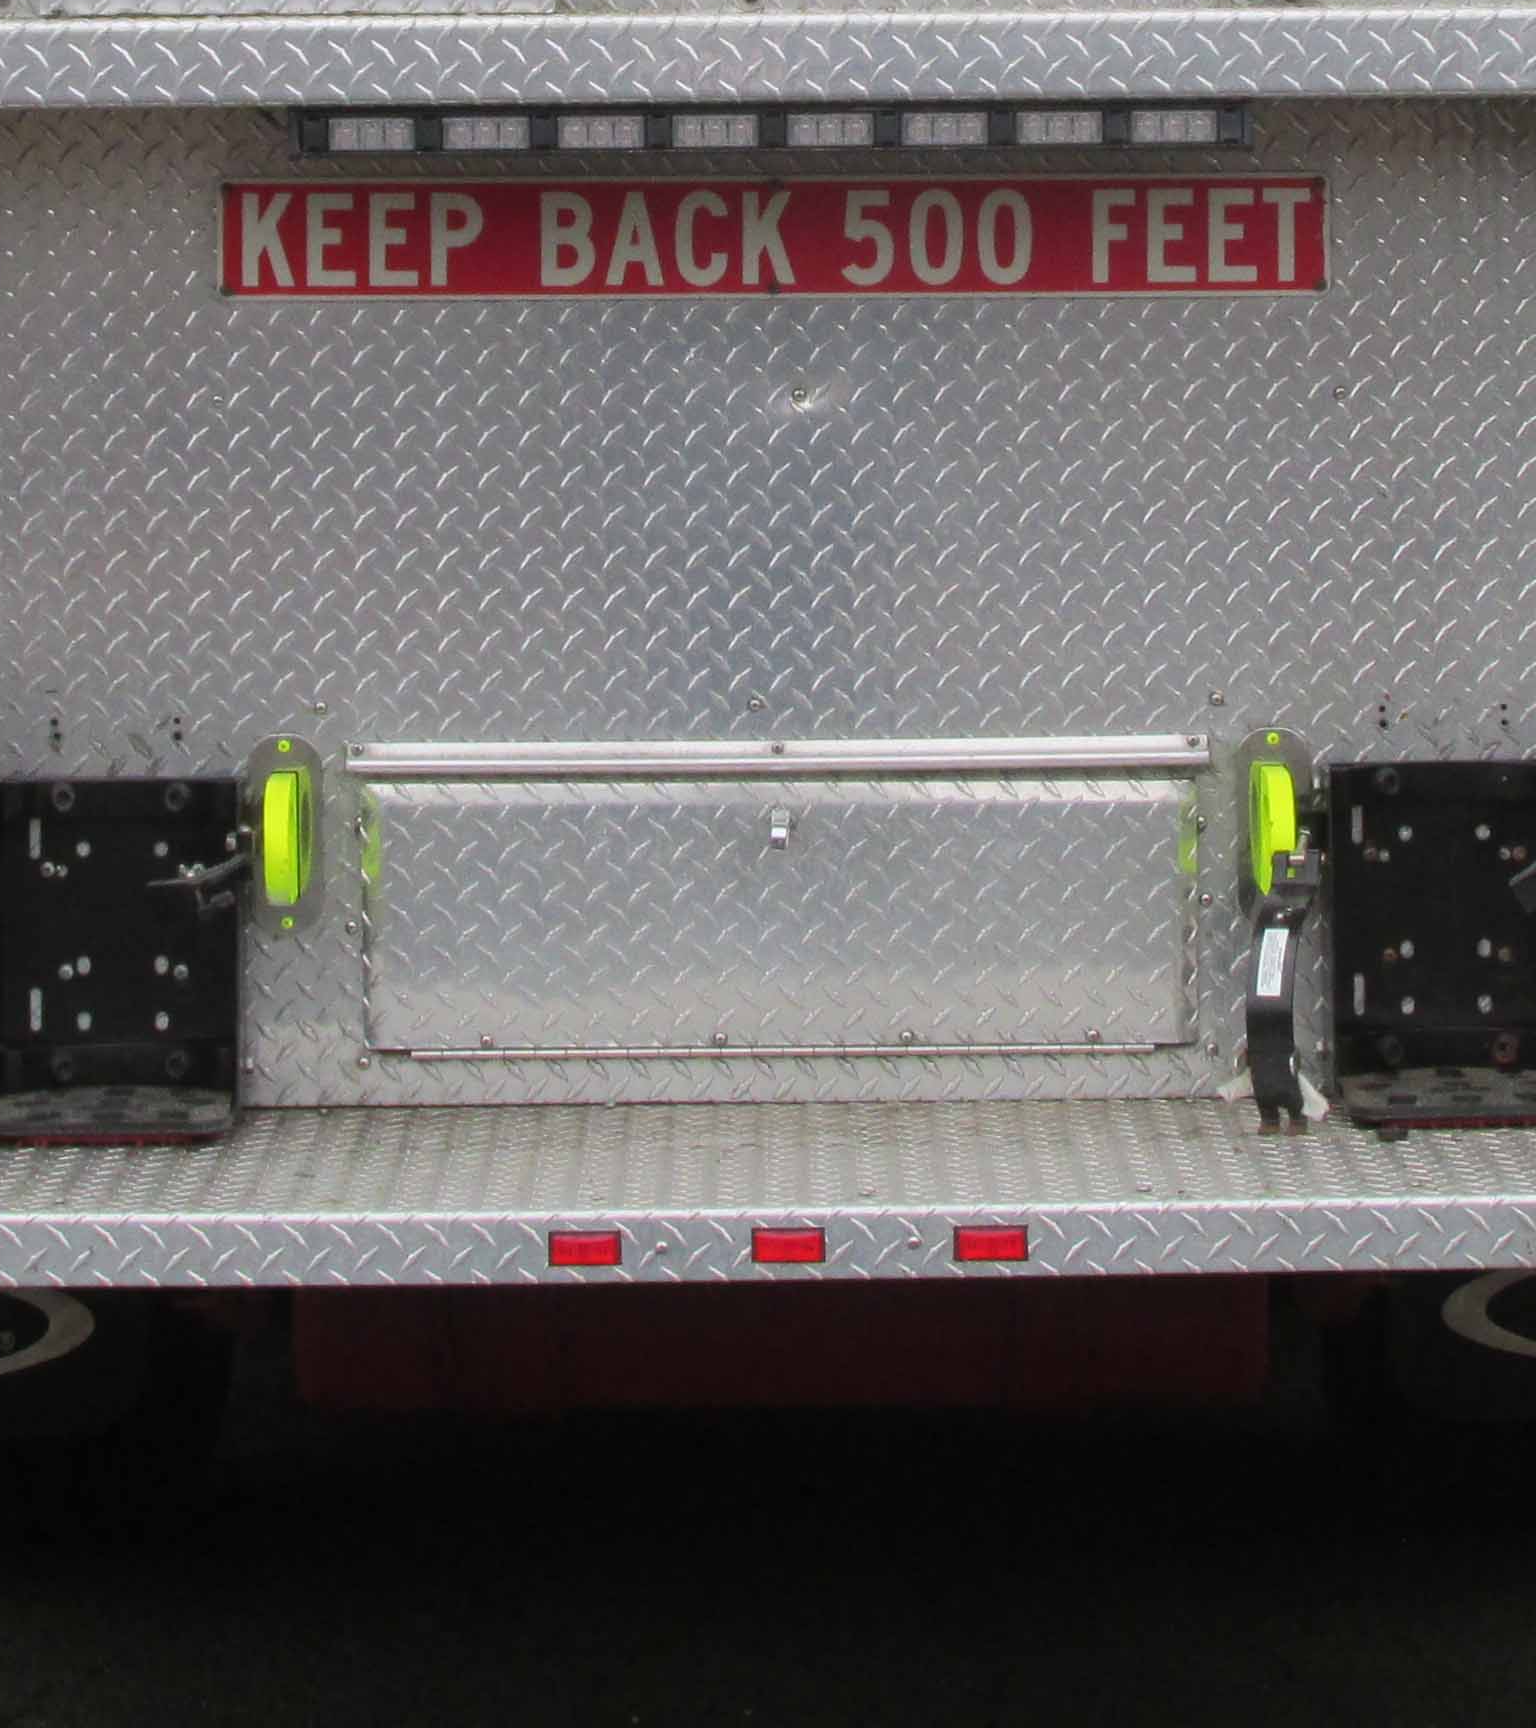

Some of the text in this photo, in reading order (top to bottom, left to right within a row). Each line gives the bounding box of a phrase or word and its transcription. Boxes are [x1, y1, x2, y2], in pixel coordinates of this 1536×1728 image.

[241, 184, 1312, 287] KEEP BACK 500 FEET
